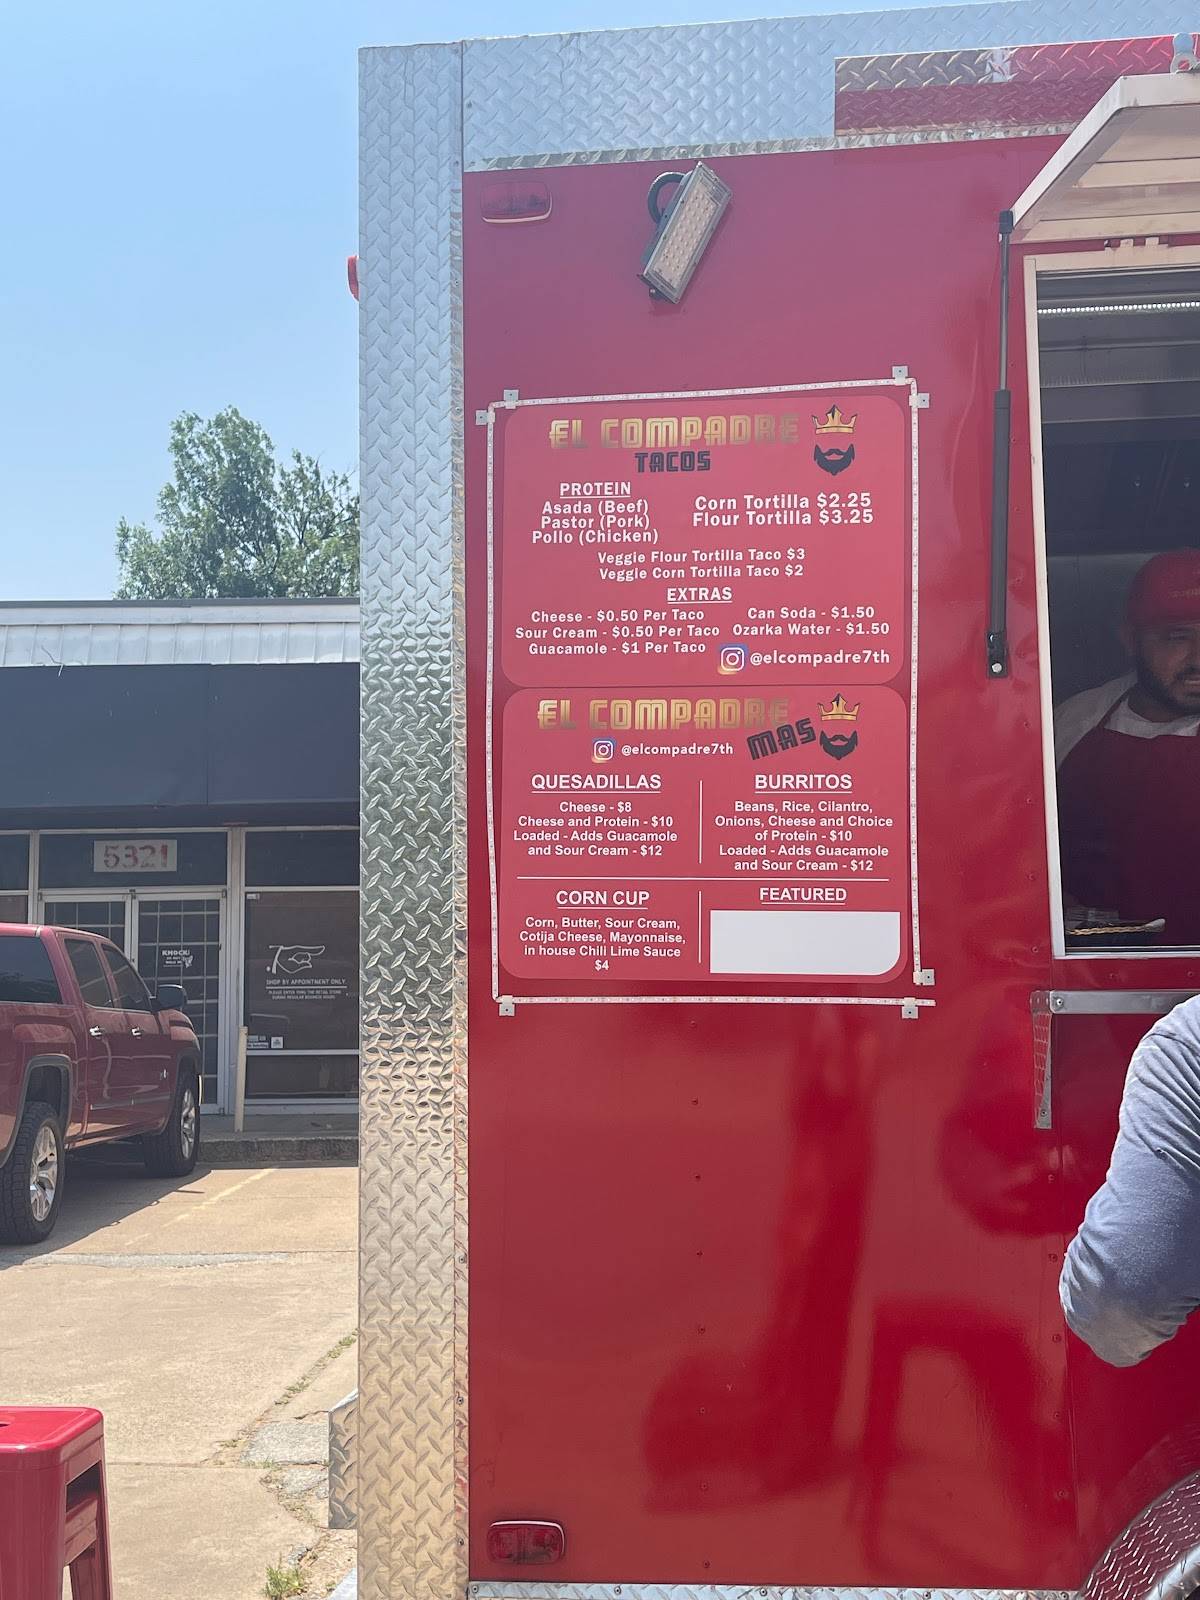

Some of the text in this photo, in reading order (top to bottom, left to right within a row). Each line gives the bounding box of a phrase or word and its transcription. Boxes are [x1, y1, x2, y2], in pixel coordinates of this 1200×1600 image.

[549, 414, 800, 449] EL COMPADRE
[634, 450, 711, 473] TACOS
[560, 482, 630, 496] PROTEIN
[542, 499, 648, 515] Asada (Beef)
[695, 493, 872, 510] Corn Tortilla $2.25
[542, 514, 649, 530] Pastor (Pork)
[694, 508, 873, 526] Flour Tortilla $3.25
[533, 529, 658, 545] Pollo (Chicken)
[598, 548, 805, 566] Veggie Flour Tortilla Taco $3
[600, 564, 803, 581] Veggie Corn Tortilla Taco $2
[667, 587, 732, 601] EXTRAS
[532, 611, 582, 622] Cheese
[597, 610, 638, 622] $0.50
[644, 610, 666, 621] Per
[672, 609, 704, 620] Taco
[748, 608, 774, 619] Can
[780, 607, 815, 618] Soda
[831, 606, 874, 619] $1.50
[516, 628, 547, 638] Sour
[553, 627, 597, 638] Cream
[612, 625, 653, 638] $0.50
[659, 626, 682, 636] Per
[687, 625, 719, 636] Taco
[733, 624, 782, 635] Ozarka
[788, 624, 830, 634] Water
[846, 622, 889, 635] $1.50
[529, 643, 607, 654] Guacamole
[622, 641, 639, 654] $1
[646, 642, 668, 653] Per
[673, 641, 705, 652] Taco
[750, 650, 889, 667] @elcompadre7th
[537, 698, 789, 730] EL COMPADRE
[746, 717, 817, 761] MAS
[622, 743, 733, 757] @elcompadre7th
[532, 775, 661, 789] QUESADILLAS
[756, 774, 852, 789] BURRITOS
[560, 802, 605, 812] Cheese
[618, 801, 631, 813] $8
[735, 801, 872, 813] Beans, Rice, Cilantro,
[519, 816, 564, 826] Cheese
[568, 816, 591, 826] and
[595, 816, 639, 827] Protein
[652, 816, 673, 827] $10
[715, 816, 892, 828] Onions, Cheese and Choice
[514, 830, 559, 840] Loaded
[570, 830, 603, 841] Adds
[607, 831, 677, 841] Guacamole
[755, 830, 768, 840] of
[772, 830, 817, 841] Protein
[830, 830, 852, 842] $10
[103, 845, 168, 869] 5321
[528, 845, 551, 855] and
[555, 845, 585, 855] Sour
[588, 845, 628, 855] Cream
[641, 845, 662, 856] $12
[720, 845, 766, 855] Loaded
[778, 845, 811, 855] Adds
[816, 845, 888, 856] Guacamole
[735, 859, 757, 870] and
[762, 860, 792, 870] Sour
[796, 860, 838, 870] Cream
[851, 859, 873, 871] $12
[556, 891, 649, 905] CORN CUP
[760, 888, 846, 900] FEATURED
[526, 917, 679, 930] Corn, Butter, Sour Cream,
[520, 931, 685, 945] Cotija Cheese, Mayonnaise,
[525, 945, 680, 956] in house Chili Lime Sauce
[595, 959, 609, 971] $4
